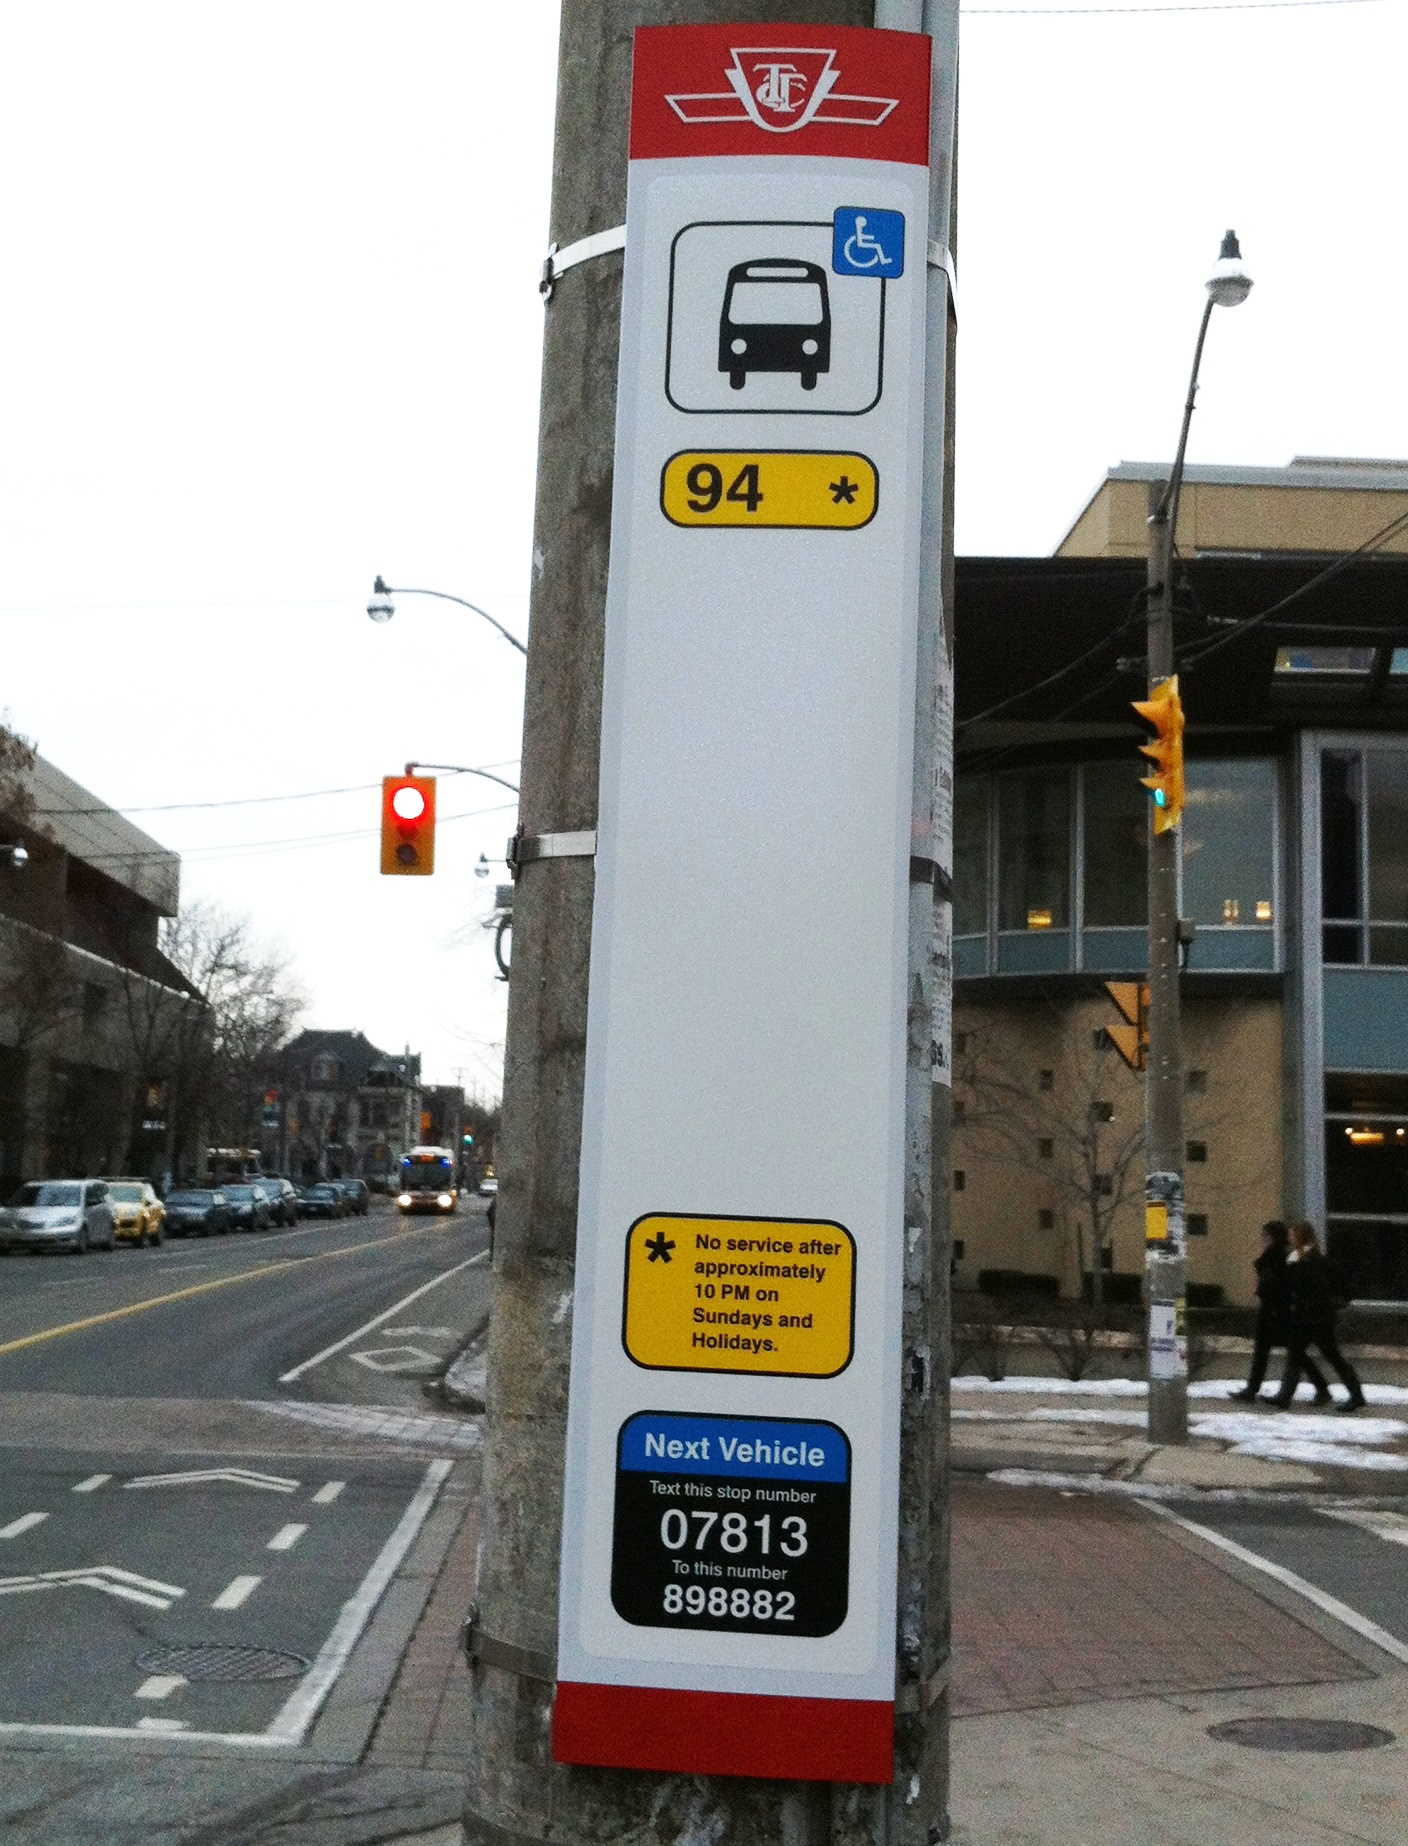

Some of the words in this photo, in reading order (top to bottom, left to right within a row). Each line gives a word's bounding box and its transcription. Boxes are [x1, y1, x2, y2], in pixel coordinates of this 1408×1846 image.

[753, 63, 808, 112] TTC
[686, 463, 764, 513] 94
[695, 1234, 721, 1250] No
[726, 1237, 793, 1254] service
[798, 1239, 842, 1256] after
[694, 1261, 826, 1284] approximately
[694, 1283, 716, 1299] 10
[721, 1284, 751, 1301] PM
[755, 1289, 779, 1302] on
[692, 1307, 773, 1330] Sundays
[777, 1313, 813, 1328] and
[691, 1331, 779, 1354] Holidays.
[645, 1432, 710, 1460] Next
[718, 1436, 825, 1467] Vehicle
[649, 1480, 680, 1495] Text
[684, 1482, 713, 1497] this
[717, 1485, 751, 1503] stop
[755, 1488, 817, 1503] number
[660, 1508, 808, 1557] 07813
[672, 1559, 690, 1574] To
[694, 1561, 723, 1576] this
[727, 1565, 788, 1580] number
[663, 1584, 795, 1621] 898882
